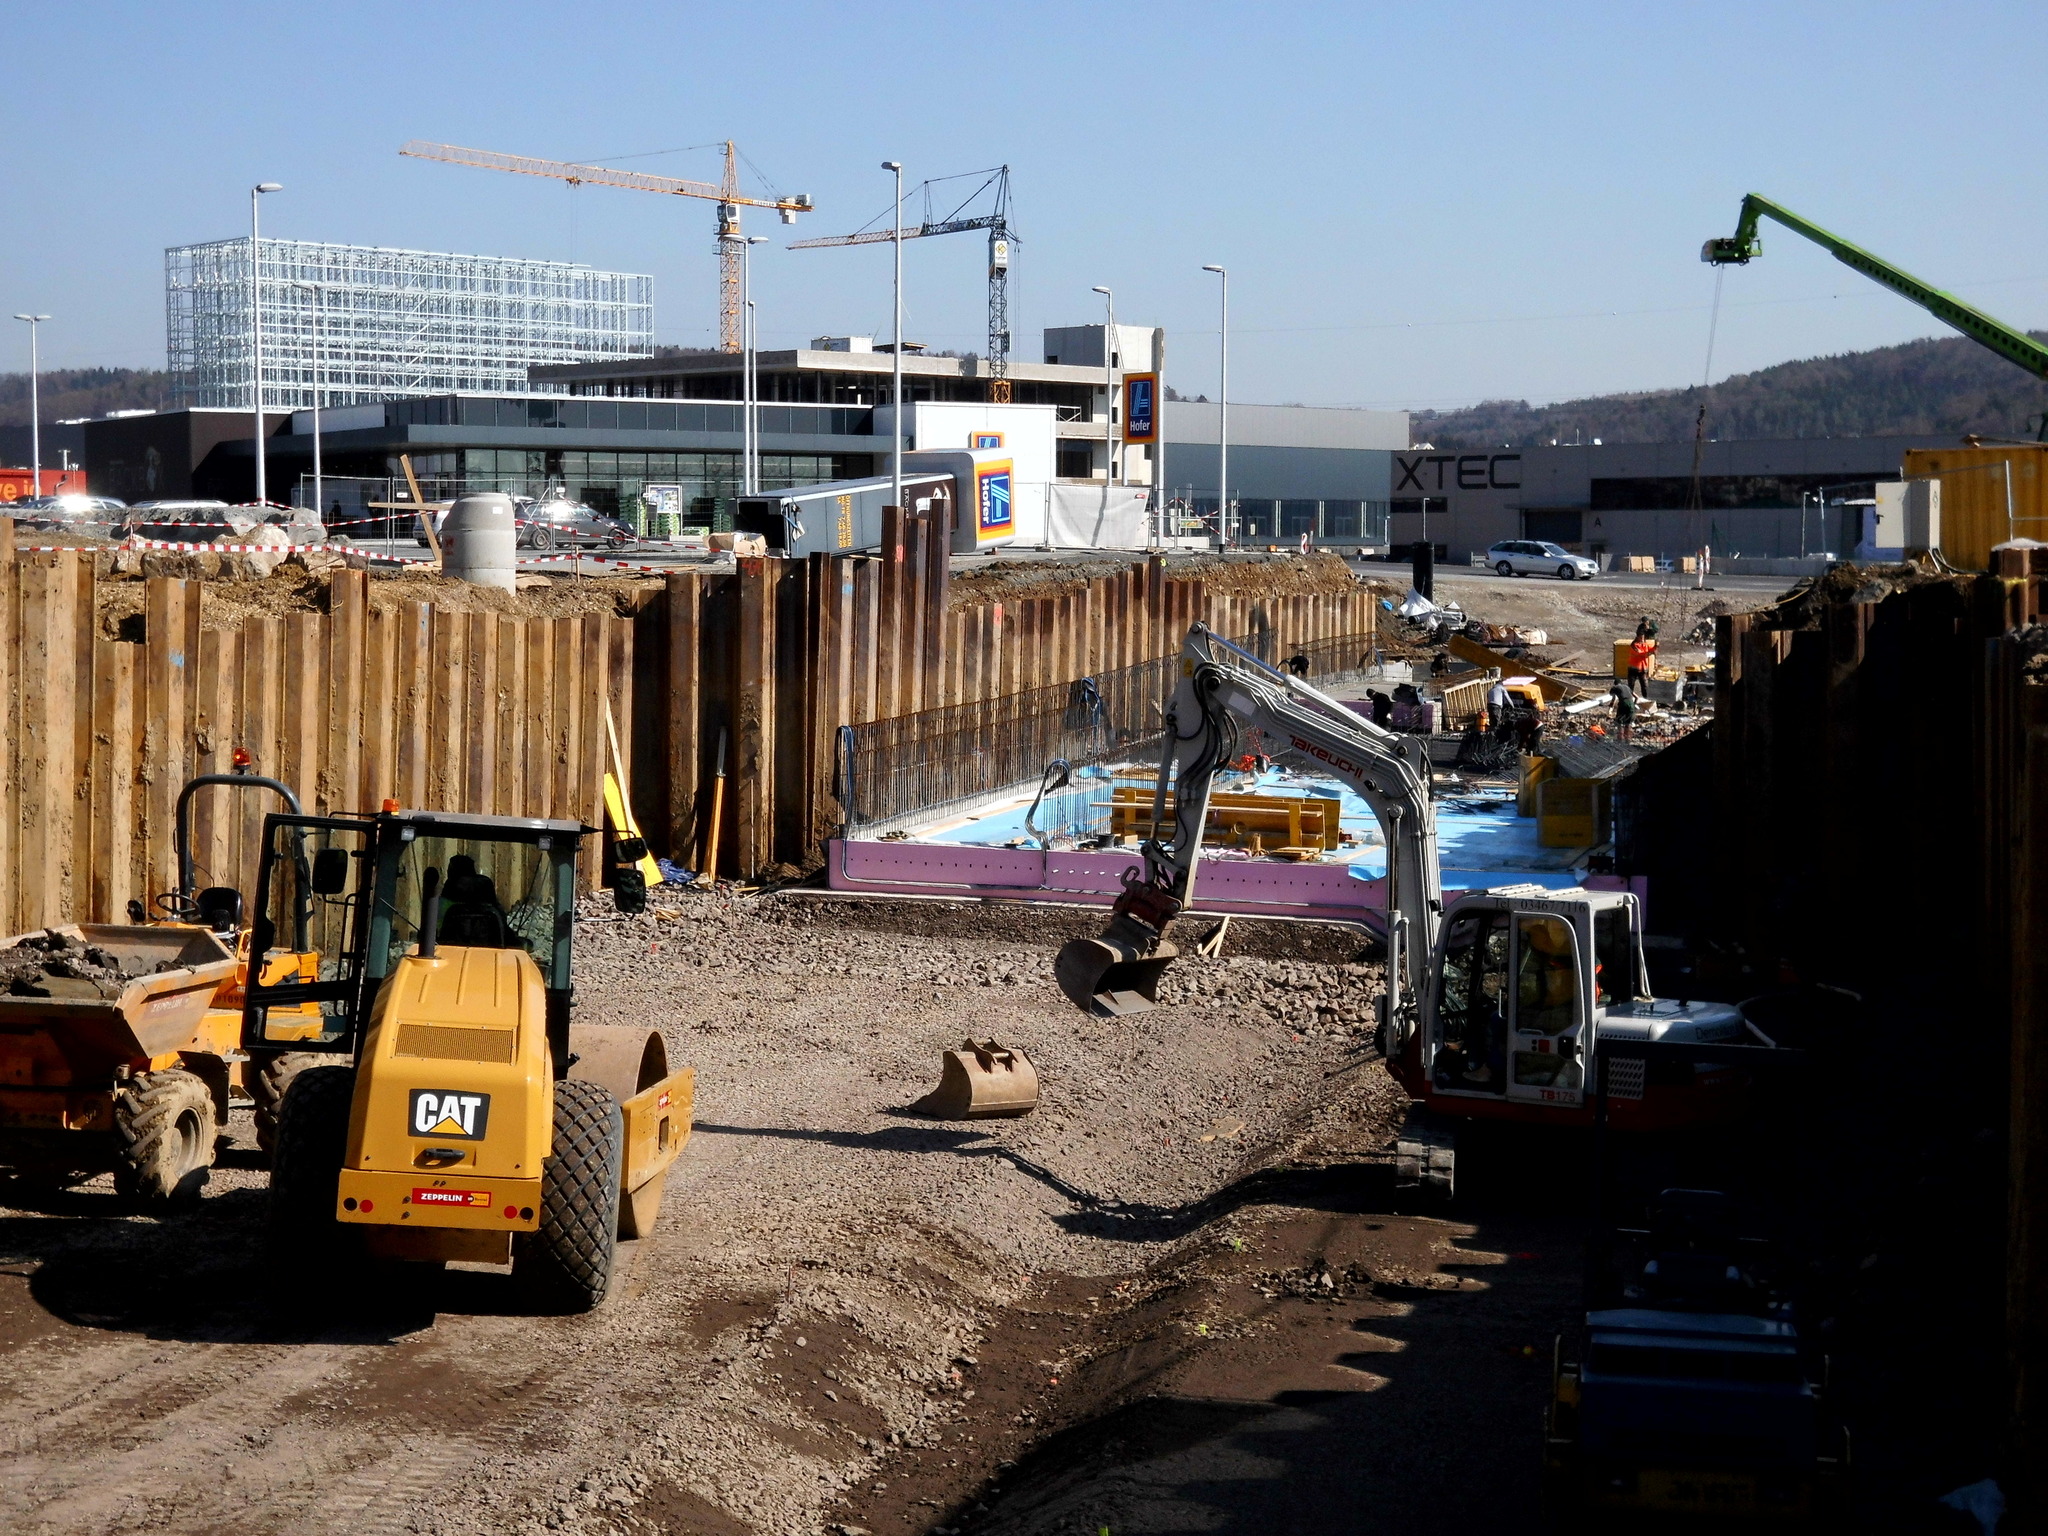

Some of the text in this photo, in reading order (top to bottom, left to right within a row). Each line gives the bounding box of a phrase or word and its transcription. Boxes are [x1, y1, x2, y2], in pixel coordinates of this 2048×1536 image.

[1129, 420, 1151, 431] Hofer
[1396, 454, 1521, 491] XTEC
[1540, 1090, 1576, 1102] TB175
[415, 1093, 482, 1136] CAT
[420, 1193, 464, 1202] ZEPPELIN
